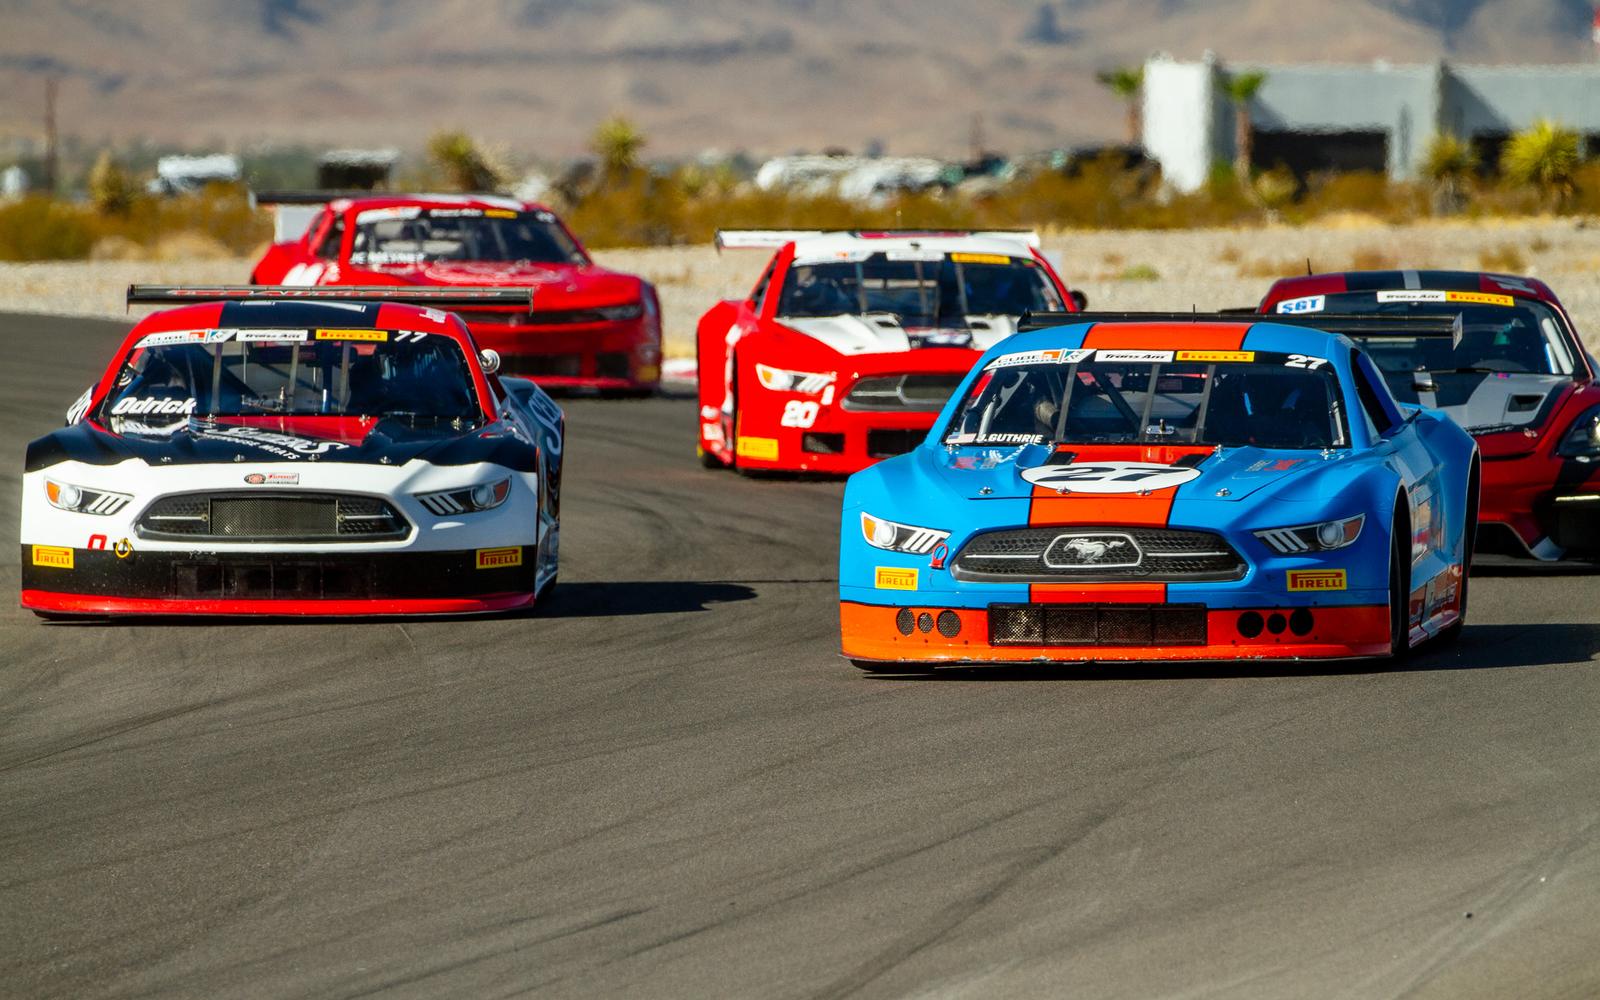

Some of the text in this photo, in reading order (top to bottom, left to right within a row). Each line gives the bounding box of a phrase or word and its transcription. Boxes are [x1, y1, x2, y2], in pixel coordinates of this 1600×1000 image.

[1281, 299, 1318, 314] SGT
[394, 329, 428, 343] 77
[1181, 352, 1249, 360] PIRELLI
[1284, 354, 1328, 370] 27
[111, 396, 197, 414] Odrick
[780, 400, 819, 428] 20
[976, 433, 1043, 443] J.GUTHRIE
[1034, 467, 1194, 482] 27
[36, 548, 70, 565] PIRELLI
[480, 549, 519, 566] PIRELLI
[878, 571, 915, 586] PIRELLI
[1290, 572, 1343, 589] PIRELLI
